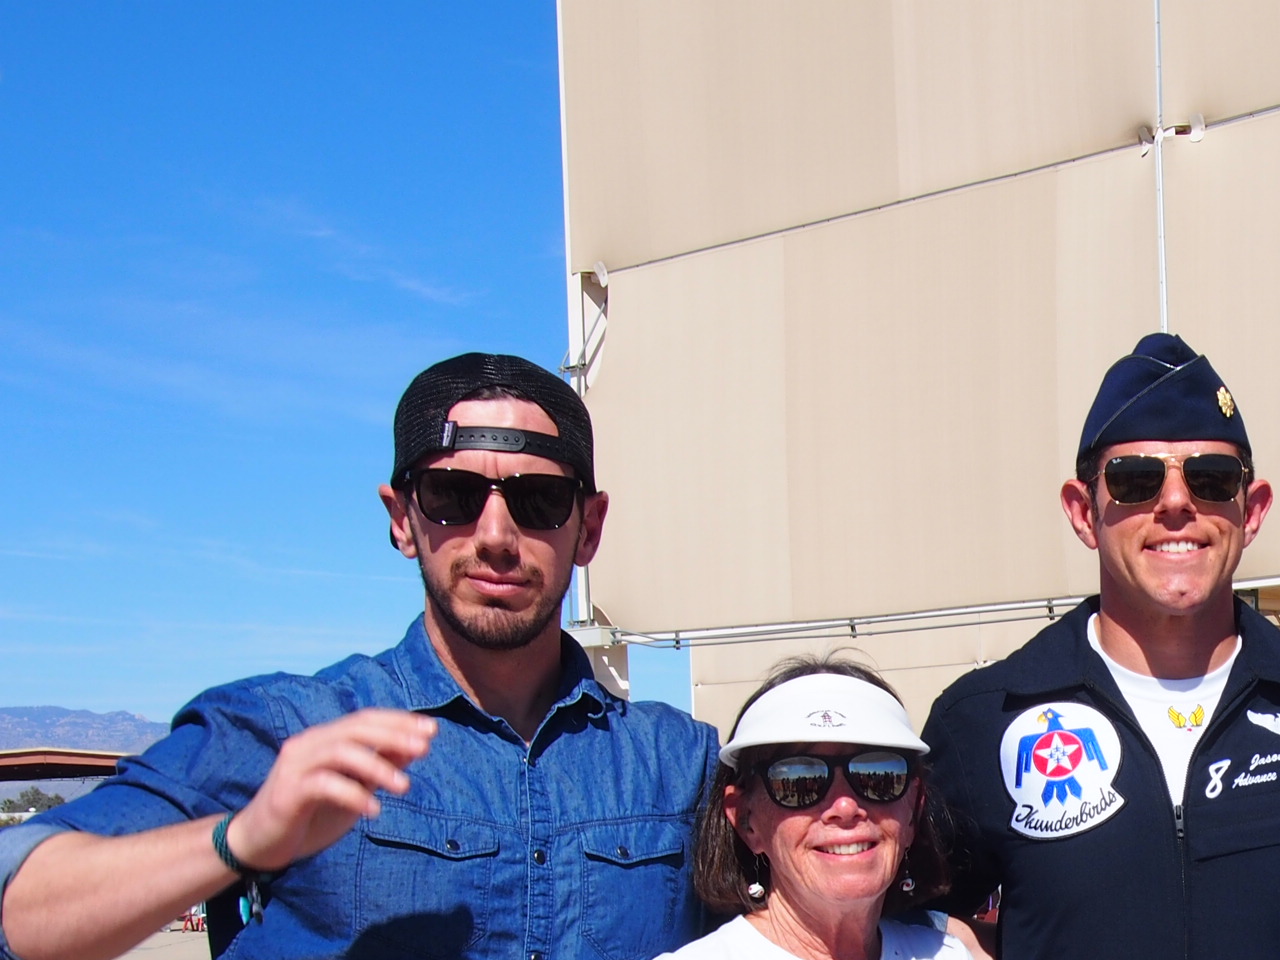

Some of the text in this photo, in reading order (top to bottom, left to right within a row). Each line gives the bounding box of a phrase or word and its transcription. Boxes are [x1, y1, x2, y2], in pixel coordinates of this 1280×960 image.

[1205, 759, 1231, 799] 8
[1232, 772, 1277, 789] Advance
[1015, 788, 1117, 832] Thunderbirds
